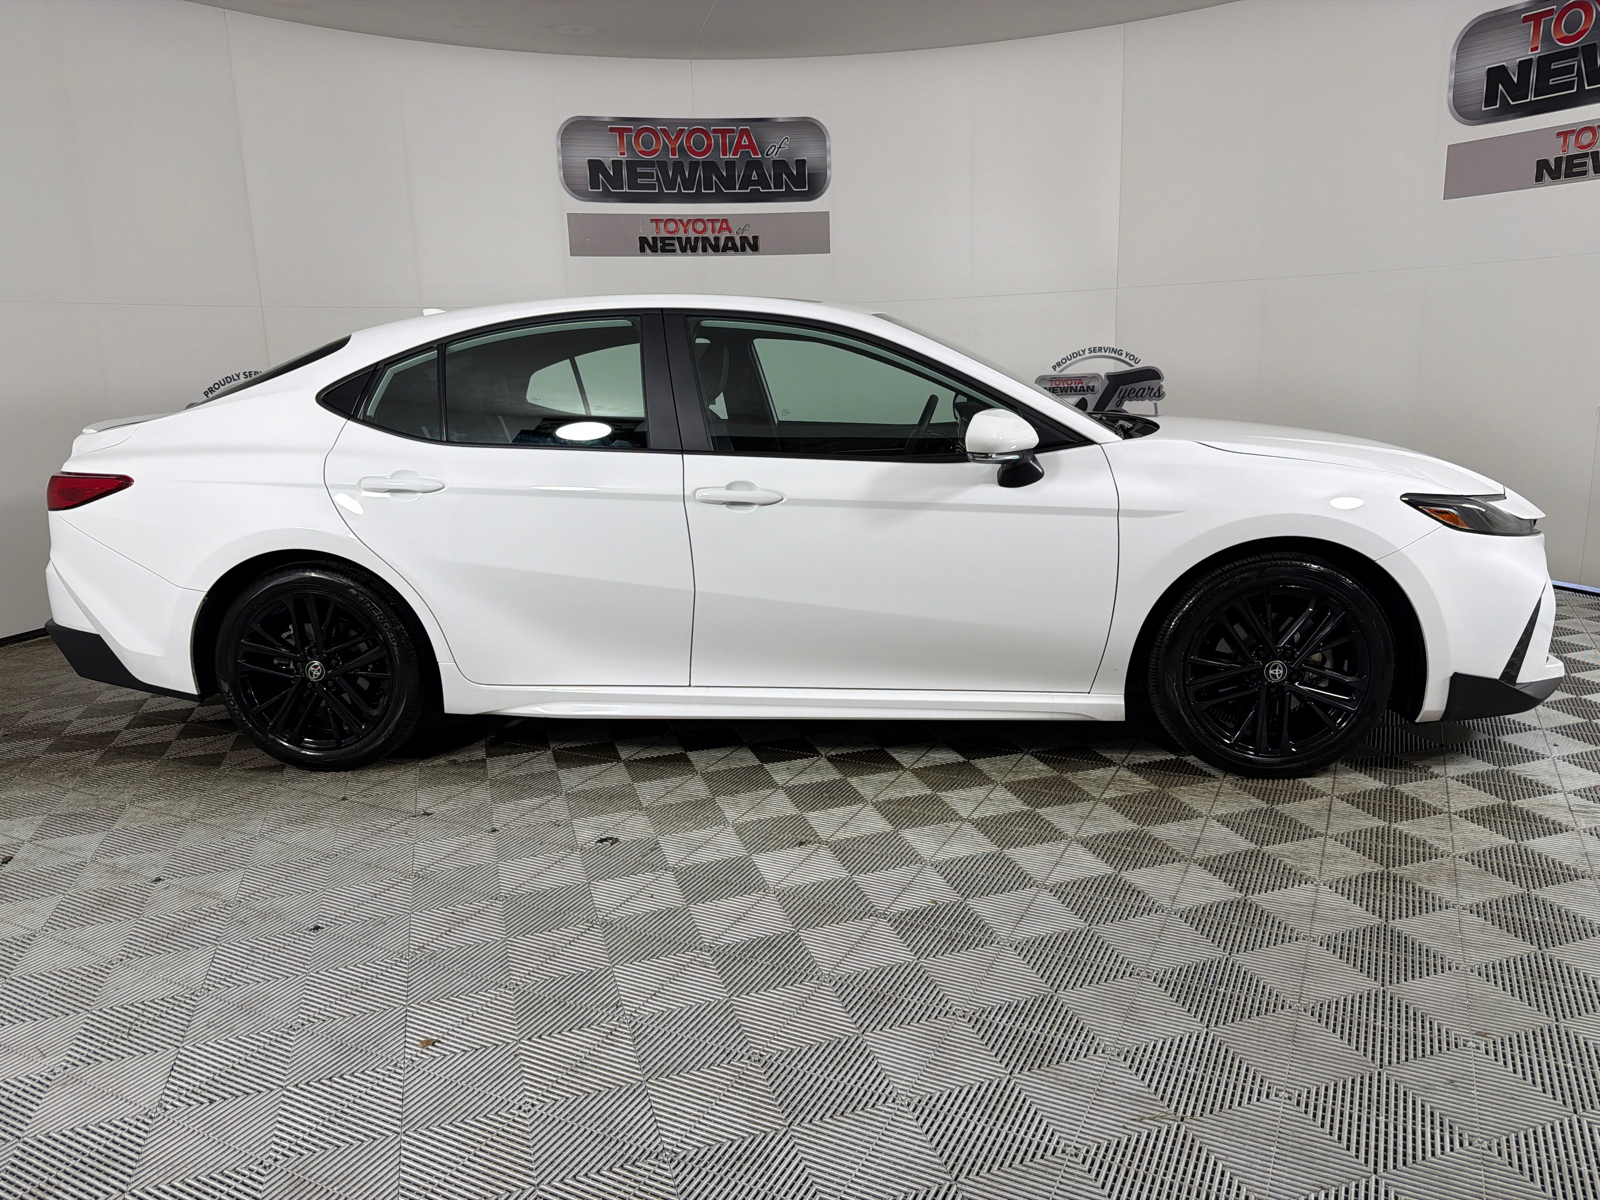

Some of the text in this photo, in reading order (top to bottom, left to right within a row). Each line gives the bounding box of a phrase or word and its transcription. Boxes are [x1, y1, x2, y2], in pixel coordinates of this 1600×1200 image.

[1521, 0, 1600, 54] TO
[608, 125, 789, 158] TOYOTA of
[1555, 124, 1600, 154] TO
[586, 158, 808, 193] NEWNAN
[1534, 150, 1600, 184] NE
[650, 218, 750, 235] TOYOTA of
[638, 235, 759, 254] NEWNAN
[1052, 346, 1141, 371] PROUDLY SERVING YOU
[203, 372, 241, 398] PROUDLY
[1049, 378, 1084, 387] TOYOTA
[1117, 385, 1164, 408] years
